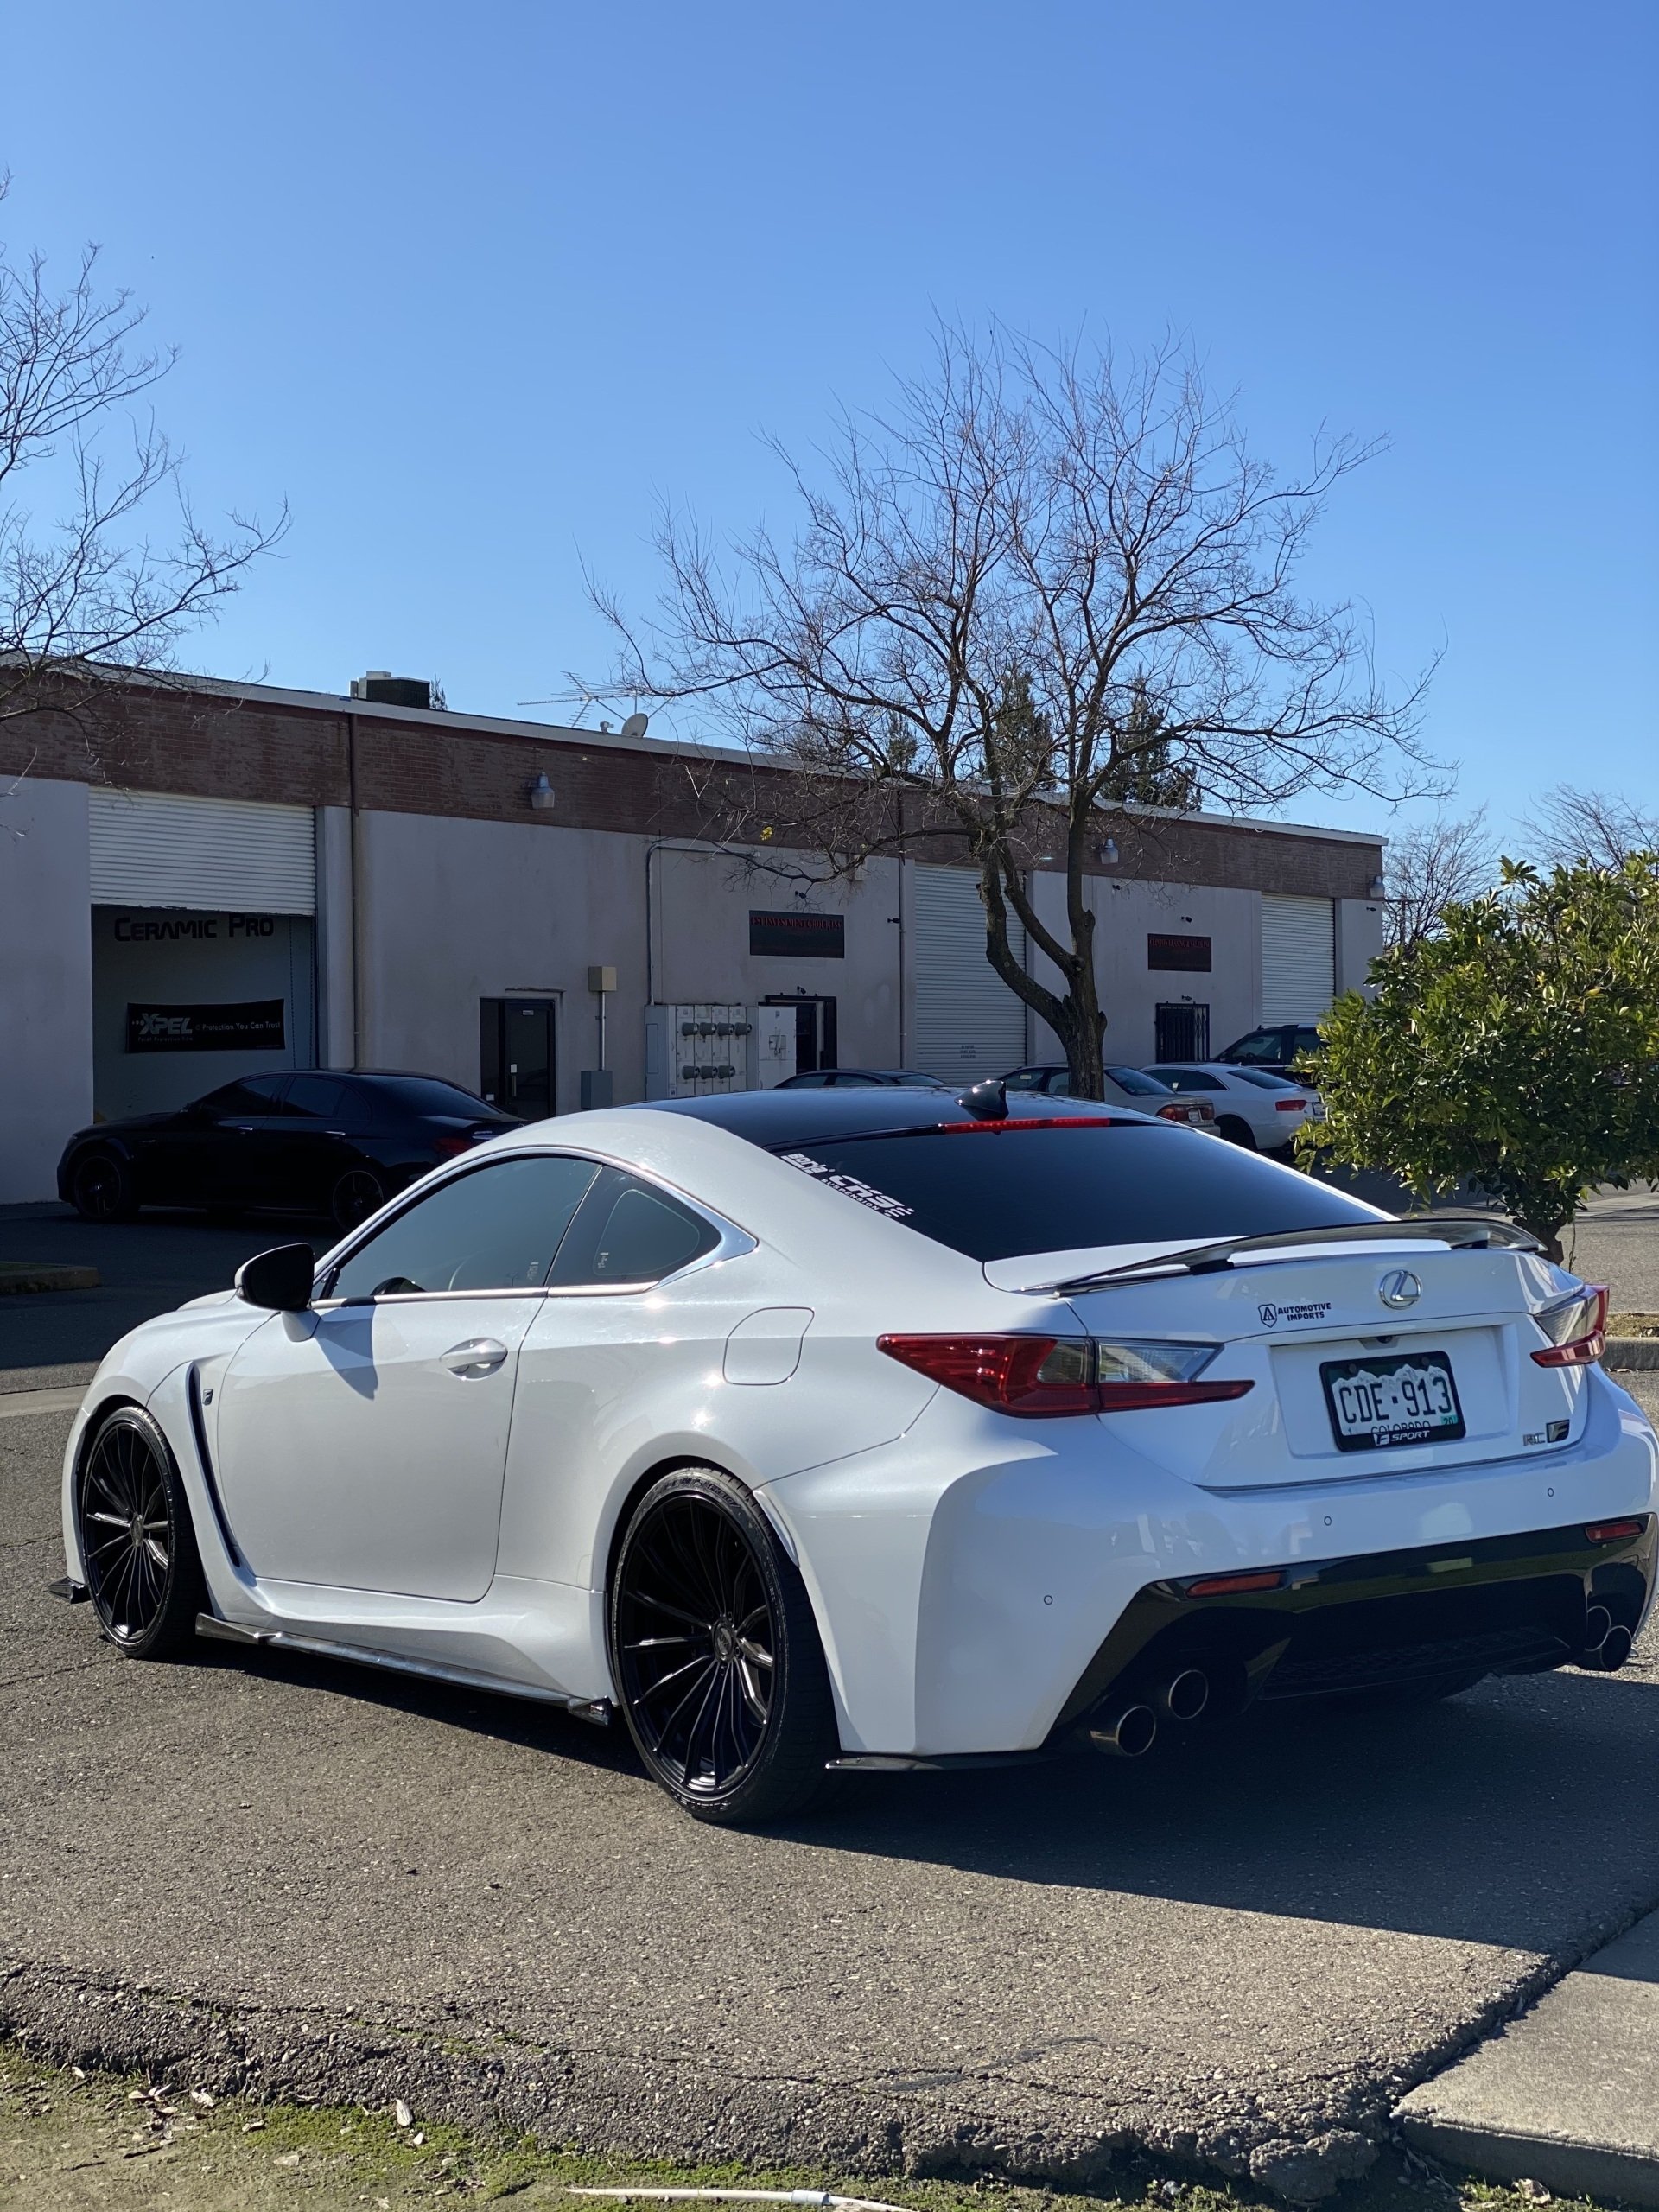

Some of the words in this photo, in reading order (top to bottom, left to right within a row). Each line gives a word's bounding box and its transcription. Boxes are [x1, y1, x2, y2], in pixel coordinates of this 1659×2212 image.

[114, 917, 217, 942] CERAMIC
[228, 912, 274, 938] PRO
[138, 1013, 193, 1035] XPEL
[265, 1020, 281, 1029] Trust
[821, 1179, 880, 1211] SUSPENSION
[1277, 1302, 1332, 1315] AUTOMOTIVE
[1287, 1311, 1325, 1321] IMPORTS
[1391, 1430, 1430, 1440] SPORT
